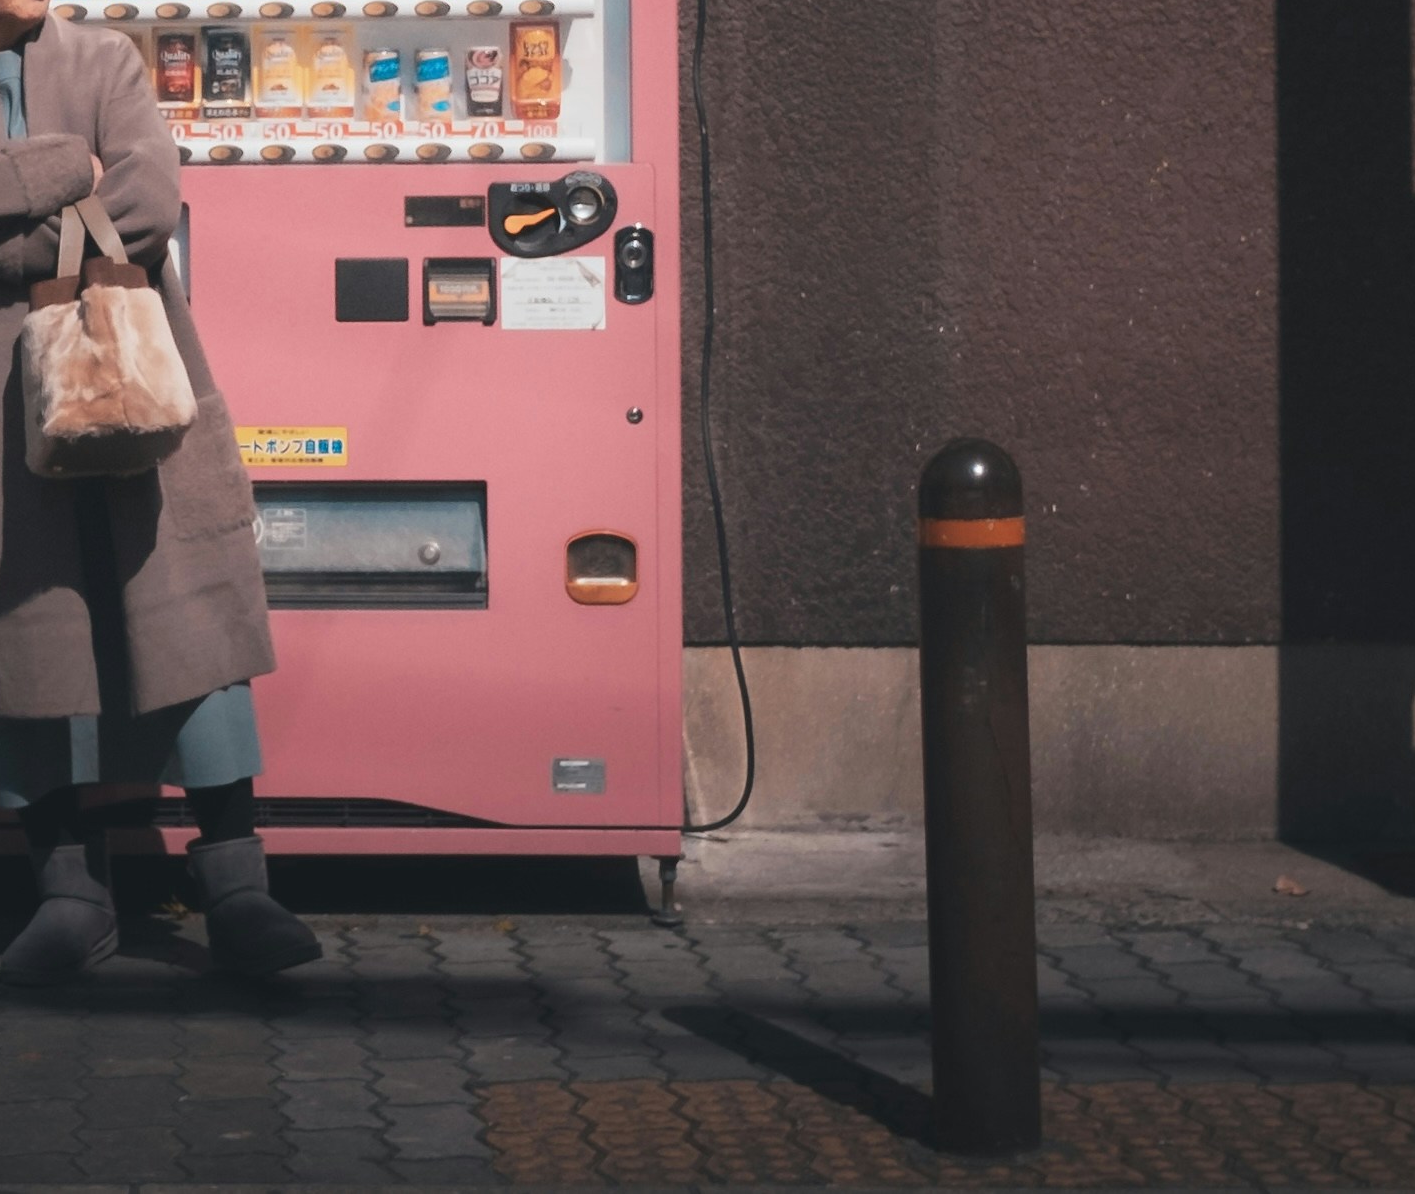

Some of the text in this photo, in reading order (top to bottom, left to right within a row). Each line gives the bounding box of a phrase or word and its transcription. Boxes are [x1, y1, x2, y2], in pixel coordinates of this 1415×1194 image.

[209, 123, 236, 140] 50
[263, 123, 291, 139] 50
[317, 123, 344, 139] 50
[369, 122, 398, 138] 50
[419, 122, 446, 138] 50
[472, 121, 499, 137] 70
[525, 123, 554, 138] 100
